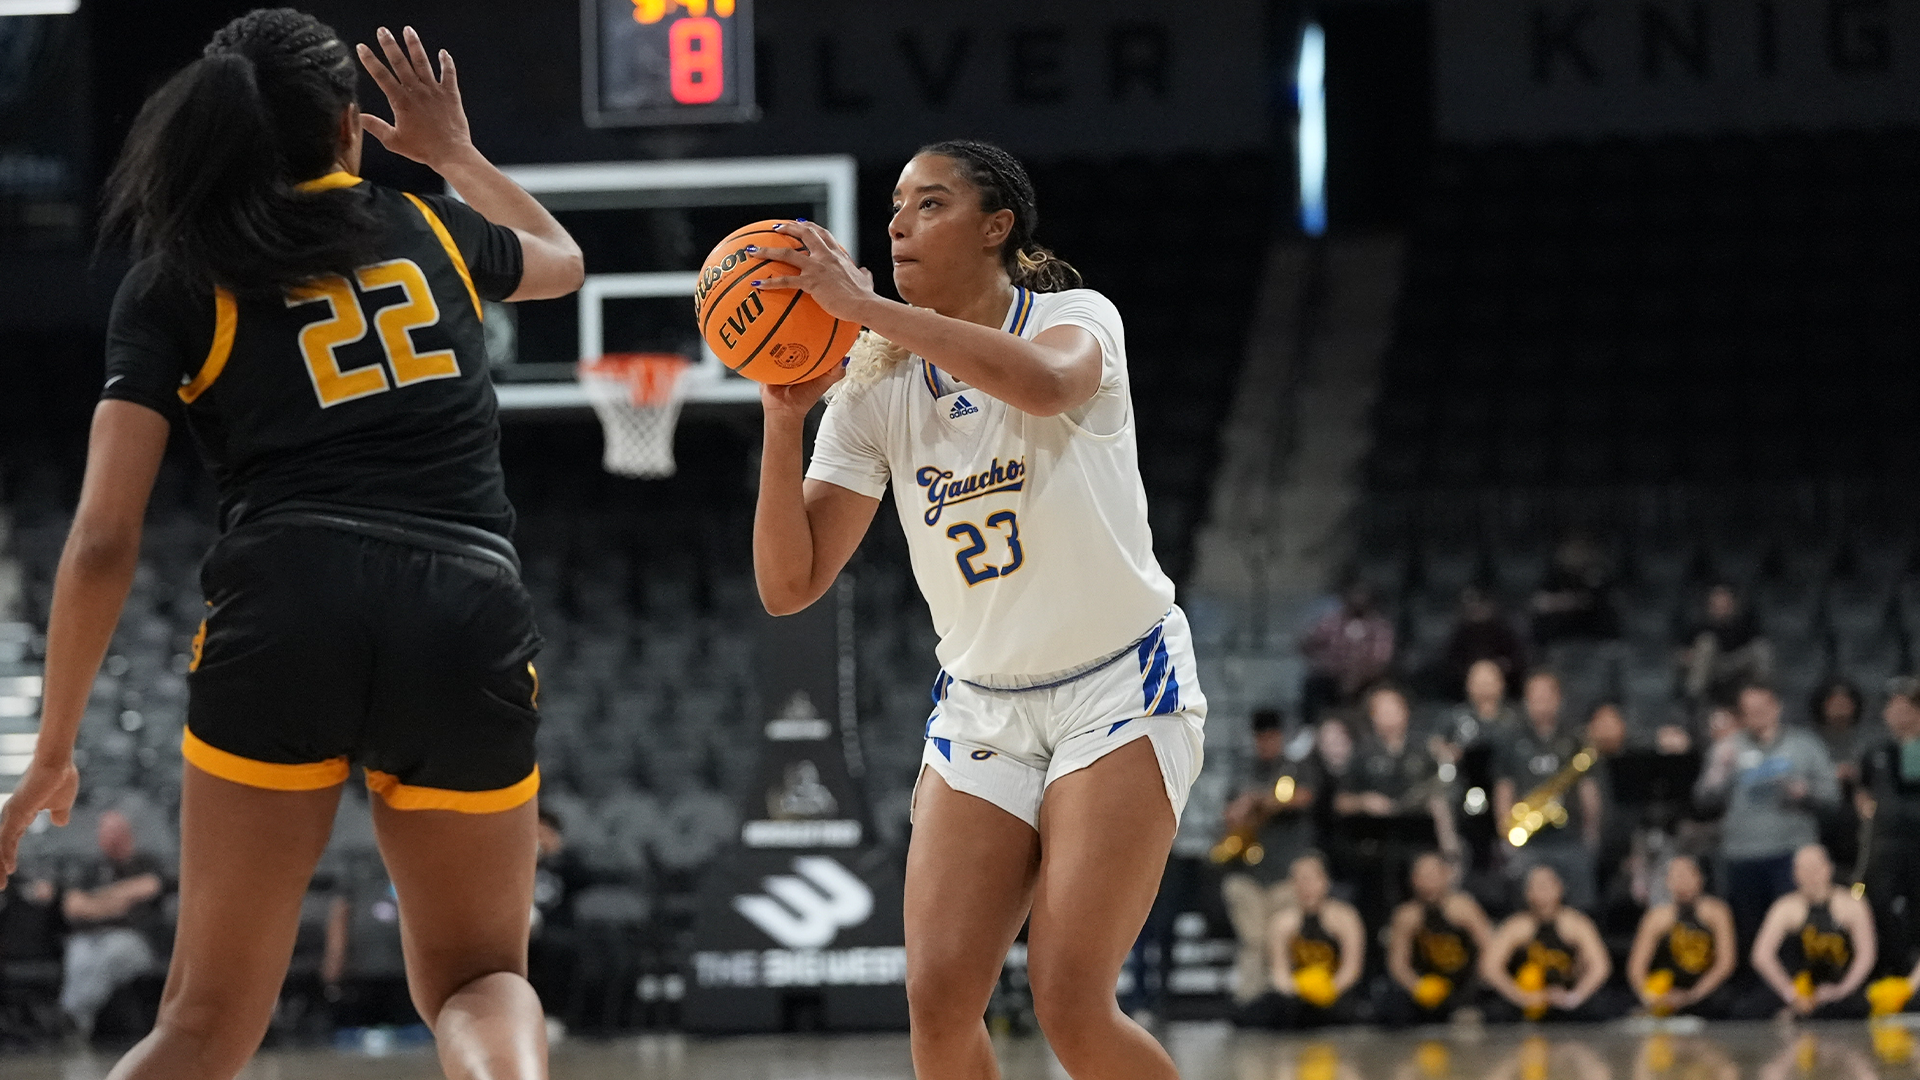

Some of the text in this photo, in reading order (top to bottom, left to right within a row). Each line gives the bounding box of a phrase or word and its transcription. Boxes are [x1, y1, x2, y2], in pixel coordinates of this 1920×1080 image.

[668, 16, 724, 105] 8
[285, 258, 461, 409] 22
[718, 291, 765, 350] EVO
[949, 404, 979, 419] adidas
[945, 508, 1026, 589] 23
